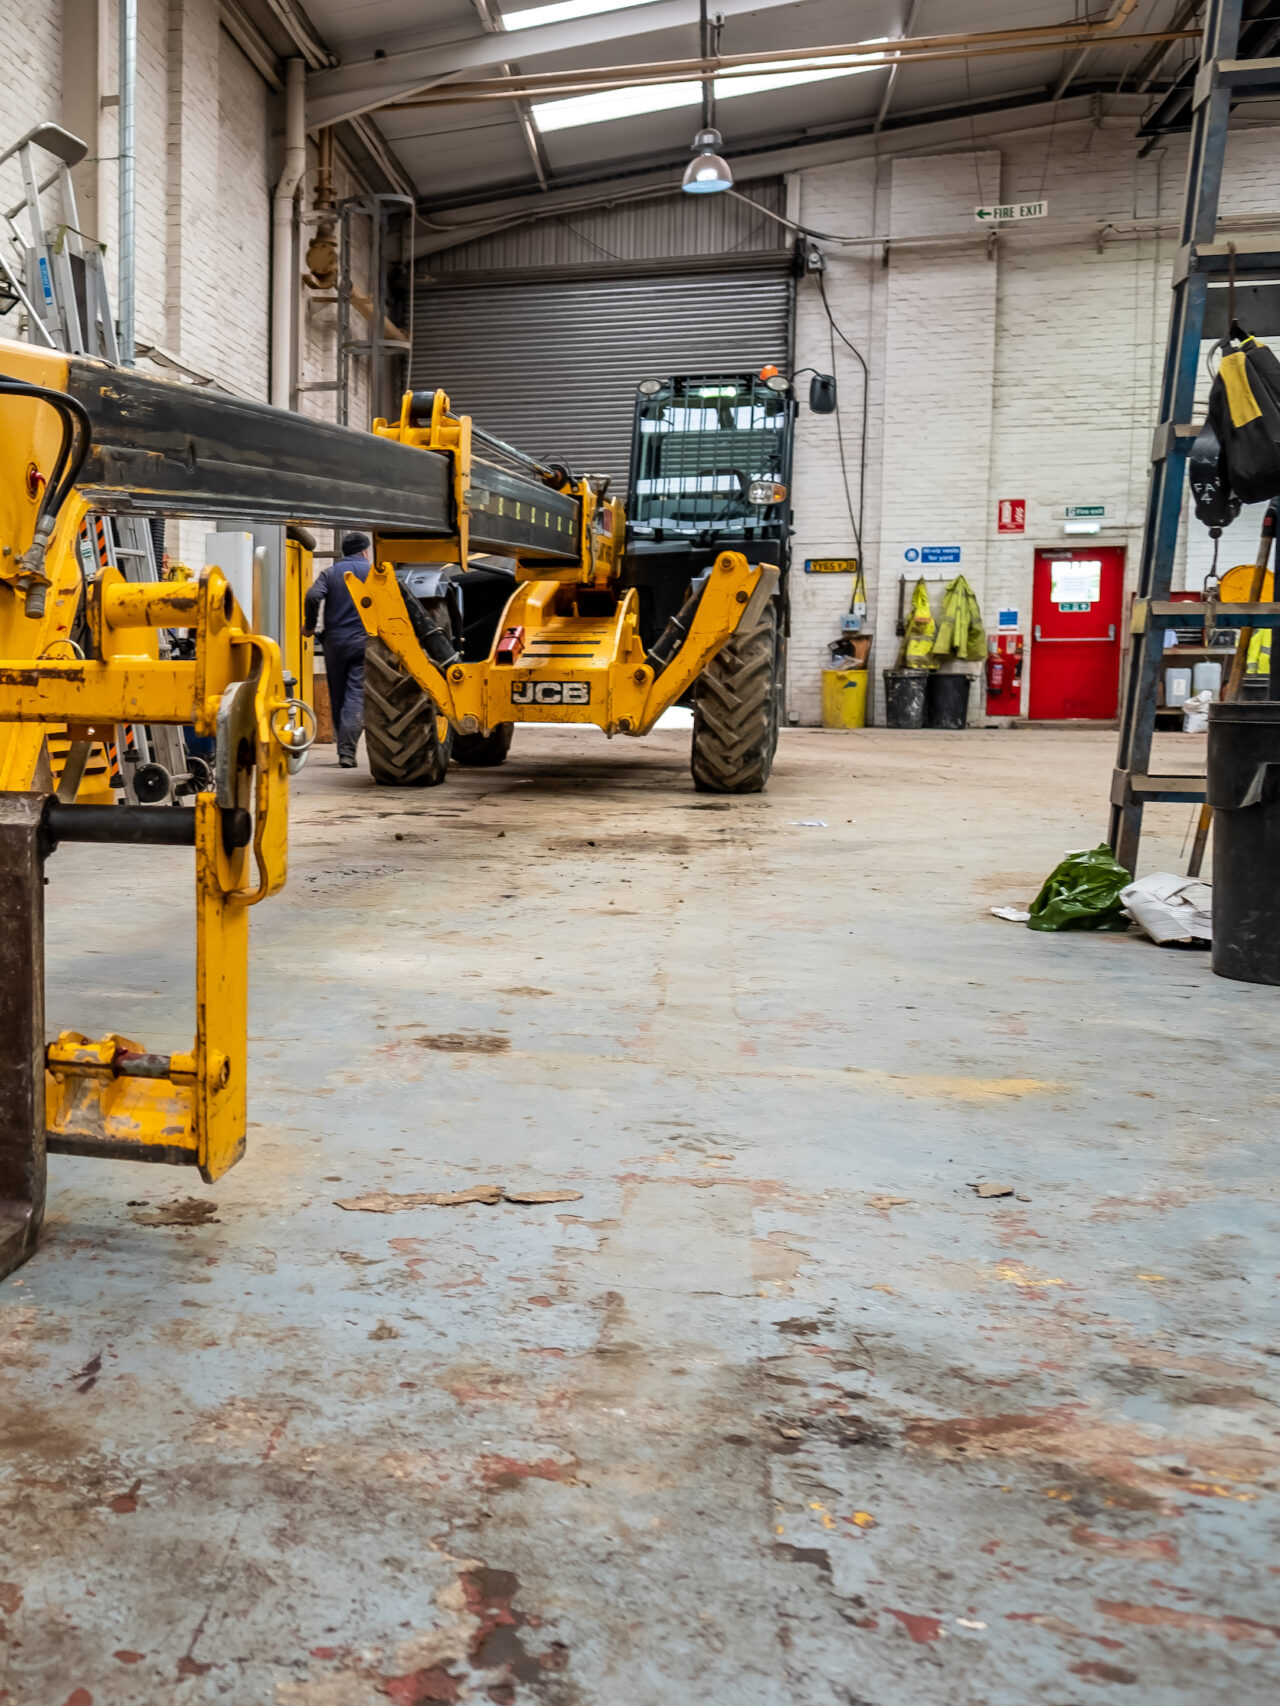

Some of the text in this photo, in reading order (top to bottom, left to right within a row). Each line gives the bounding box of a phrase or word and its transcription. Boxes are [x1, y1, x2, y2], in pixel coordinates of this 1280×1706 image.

[993, 203, 1044, 219] FIRE EXIT
[1200, 493, 1213, 504] 4
[512, 682, 589, 704] JCB
